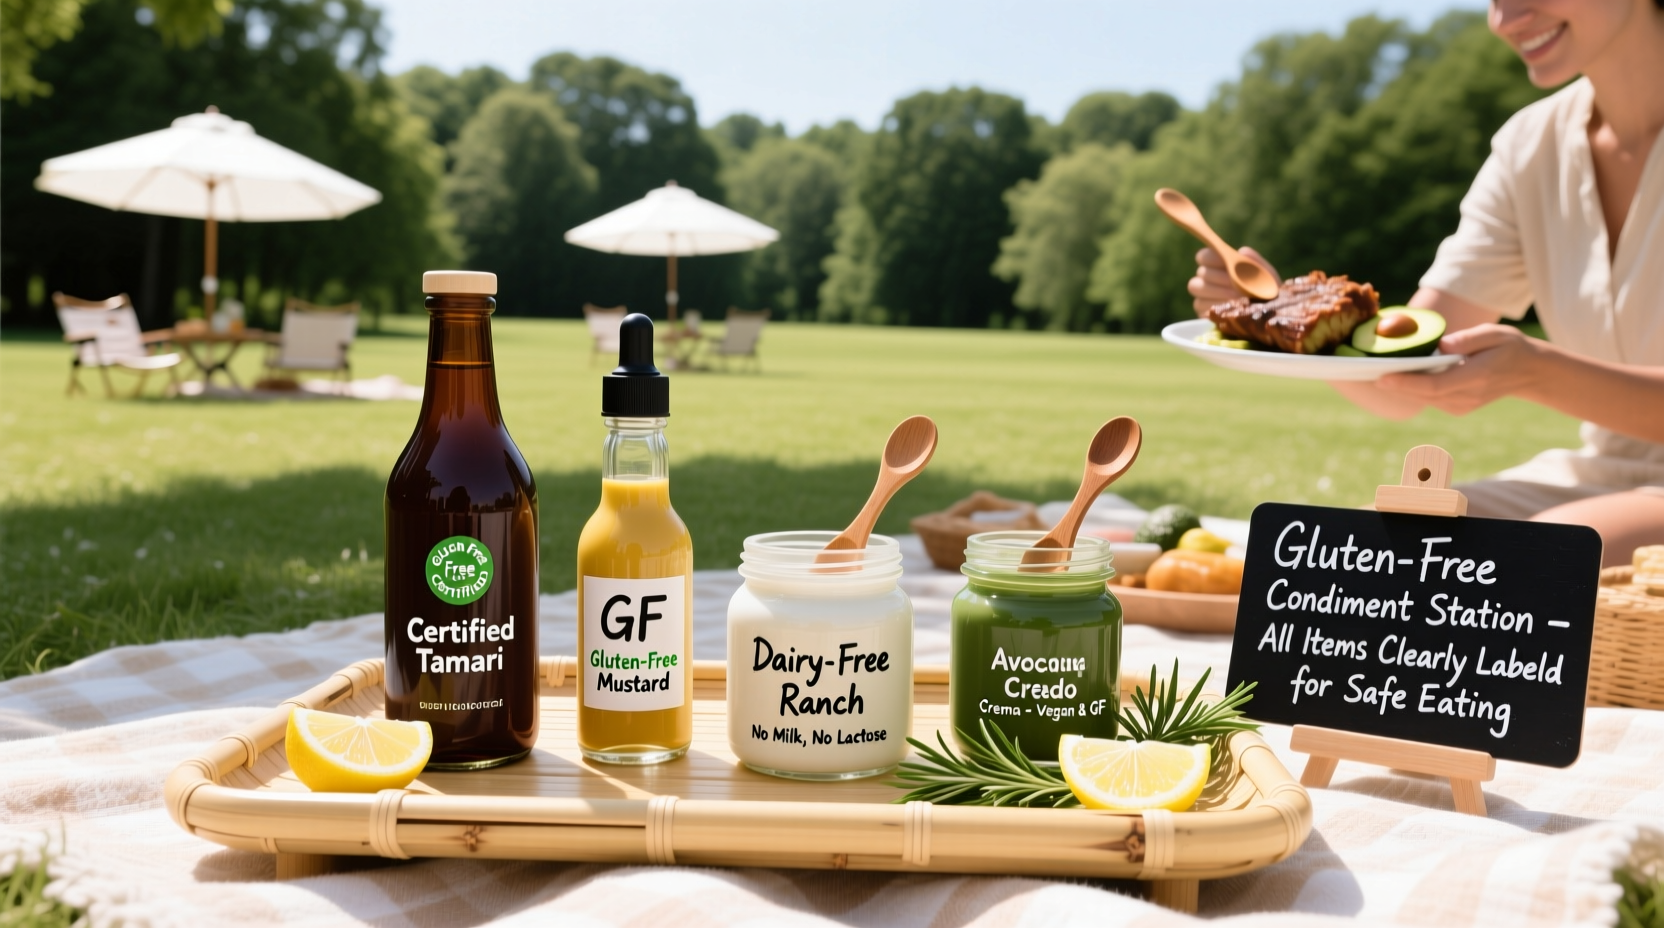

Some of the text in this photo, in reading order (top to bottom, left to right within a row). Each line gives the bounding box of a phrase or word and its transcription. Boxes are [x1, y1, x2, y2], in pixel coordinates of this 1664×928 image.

[1274, 520, 1497, 585] Gluten-Free
[601, 594, 667, 642] GF
[1266, 578, 1414, 622] Condiment
[1425, 593, 1534, 634] Station
[407, 615, 515, 643] Certified
[416, 646, 503, 673] Tamari
[590, 649, 678, 669] Gluten-Free
[753, 636, 890, 687] Dairy-Free
[1258, 622, 1564, 688] All Items Clearly Labeld
[597, 671, 670, 692] Mustard
[780, 682, 864, 716] Ranch
[979, 699, 1021, 716] Crema
[1036, 704, 1075, 722] Vegan
[1090, 699, 1107, 715] GF
[1290, 665, 1511, 738] for Safe Eating
[752, 724, 887, 748] No Milk, No Lactose
